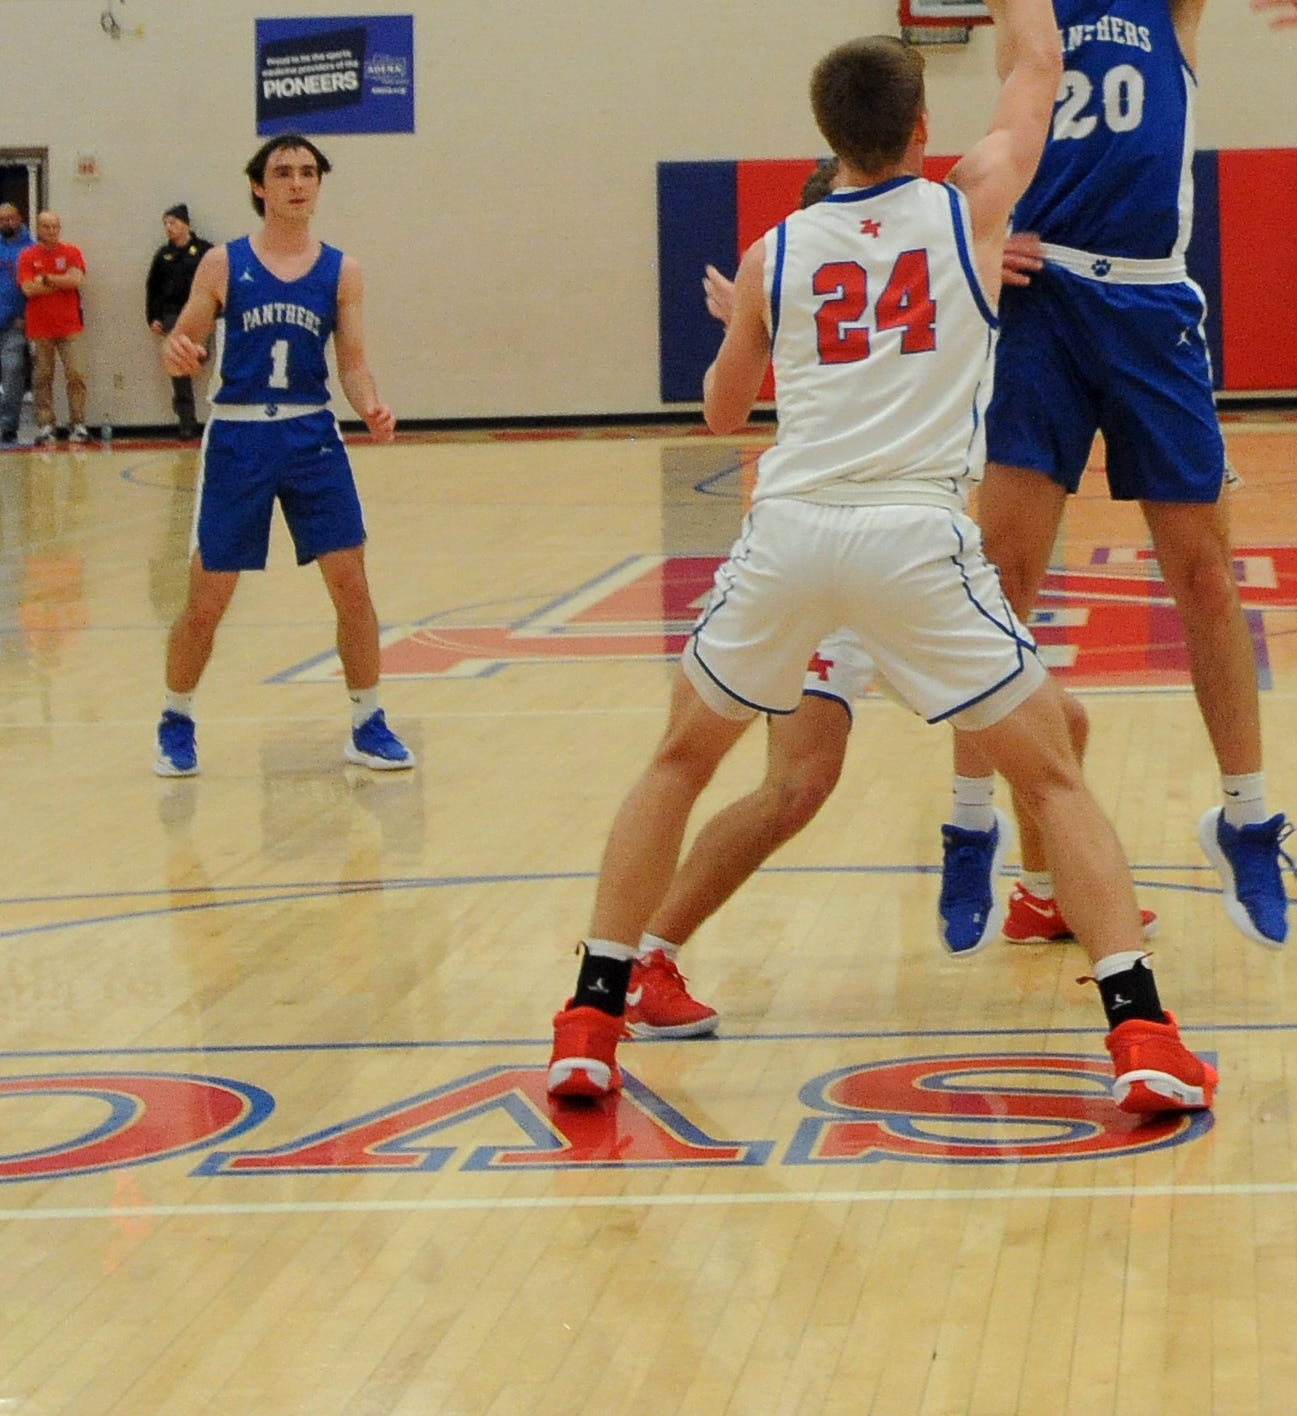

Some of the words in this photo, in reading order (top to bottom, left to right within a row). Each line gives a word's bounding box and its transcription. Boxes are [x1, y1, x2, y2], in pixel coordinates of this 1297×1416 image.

[263, 70, 360, 100] PIONEERS
[1053, 64, 1144, 141] 20
[812, 248, 937, 366] 24
[268, 339, 289, 389] 1
